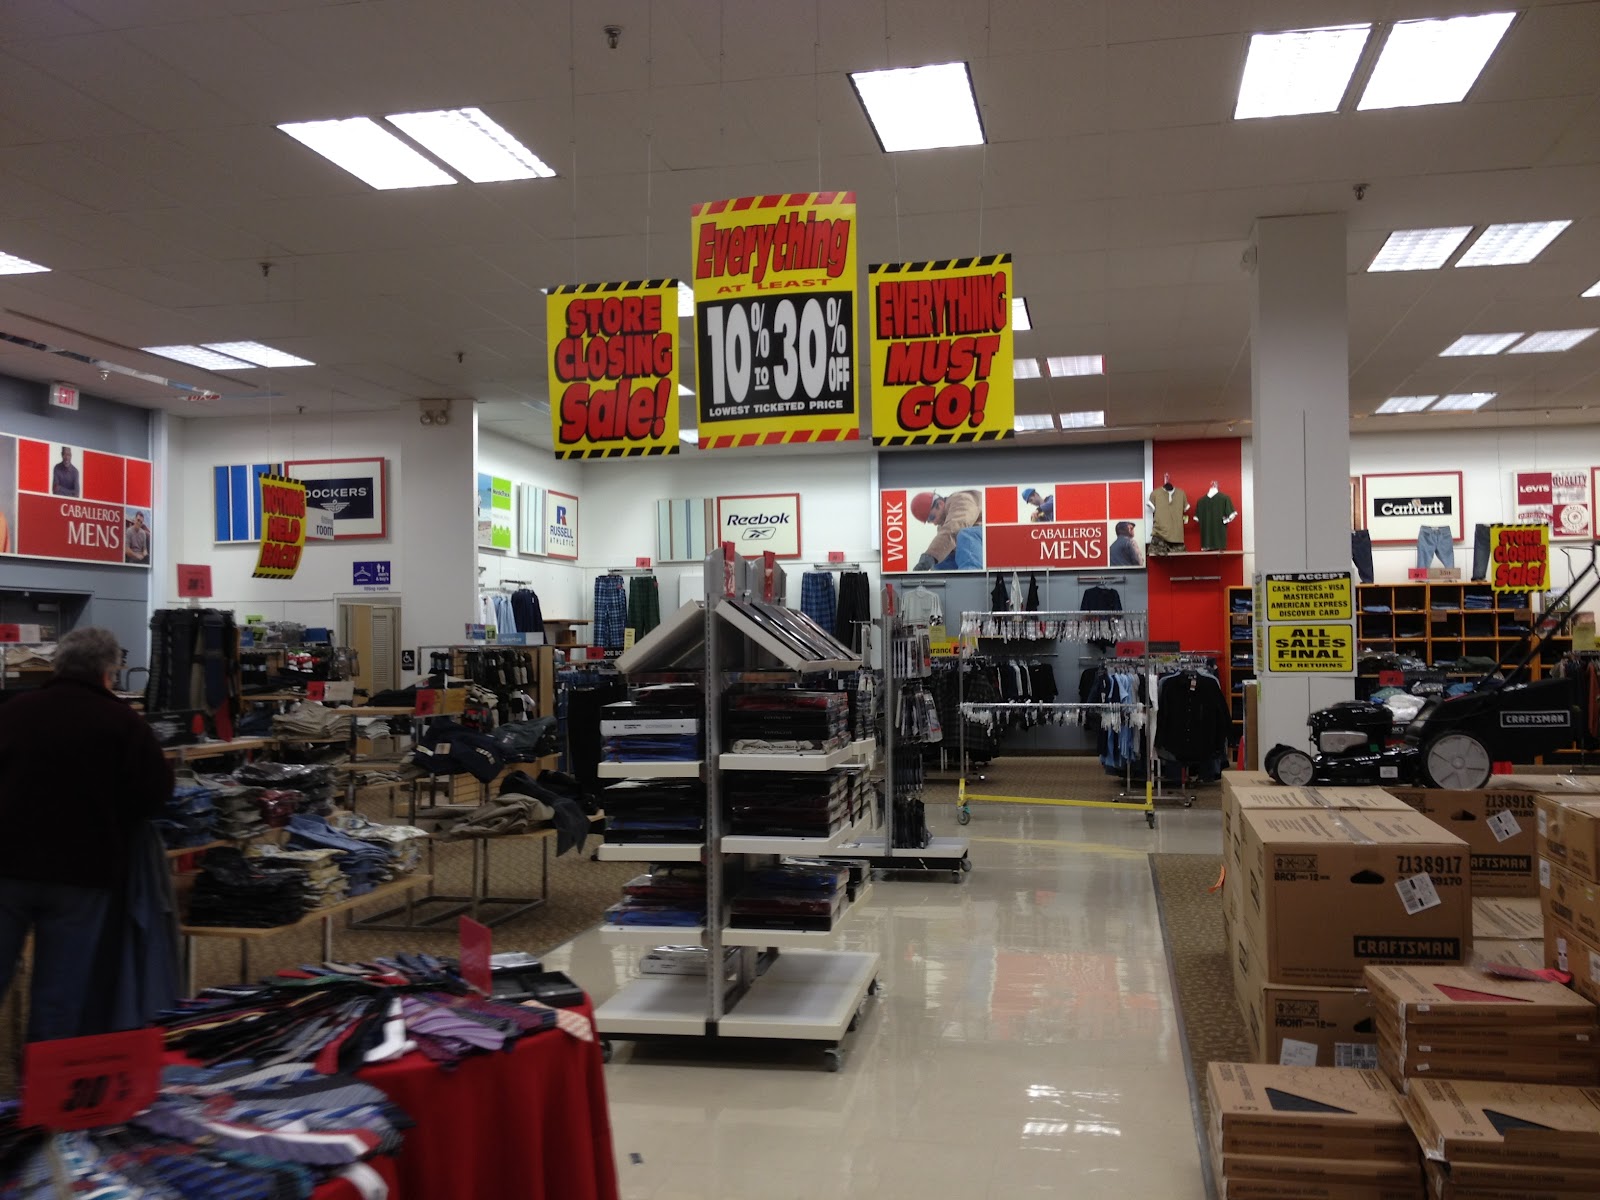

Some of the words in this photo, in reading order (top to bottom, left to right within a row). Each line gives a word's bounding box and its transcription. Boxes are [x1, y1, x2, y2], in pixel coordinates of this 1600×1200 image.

[696, 211, 850, 283] Everything
[717, 282, 746, 294] AT
[757, 278, 832, 291] LEAST
[877, 272, 1007, 340] EVERYTHING
[566, 294, 661, 337] STORE
[555, 331, 672, 382] CLOSING
[883, 335, 1000, 386] MUST
[754, 367, 769, 390] TO
[829, 357, 850, 392] OFF
[58, 387, 75, 406] EXIT
[560, 377, 671, 443] Sale!
[709, 404, 750, 417] LOWEST
[754, 401, 806, 414] TICKETED
[809, 399, 843, 411] PRICE
[898, 382, 989, 431] GO!
[60, 503, 121, 523] CABALLEROS
[1381, 499, 1444, 516] Carhartt
[727, 512, 790, 527] Reebok
[67, 521, 120, 549] MENS
[267, 515, 301, 543] HELD
[550, 525, 573, 539] RUSSELL
[887, 501, 903, 562] WORK
[1031, 527, 1102, 540] CABALLEROS
[550, 537, 574, 547] ATHLETIC
[1499, 530, 1541, 546] STORE
[1040, 540, 1102, 561] MENS
[1494, 544, 1547, 563] CLOSING
[1495, 562, 1547, 587] Sale!
[1283, 592, 1334, 600] MASTERCARD
[1296, 584, 1323, 592] CHECKS
[1314, 600, 1348, 608] EXPRESS
[1291, 629, 1330, 638] ALL
[1275, 638, 1346, 648] SALES
[1278, 649, 1344, 659] FINAL
[1506, 714, 1565, 723] CRAFTSMAN
[1485, 794, 1534, 808] 7138918
[1397, 856, 1462, 873] 7138917
[1471, 857, 1527, 869] AFTSMAN
[1358, 940, 1454, 956] CRAFTSMAN
